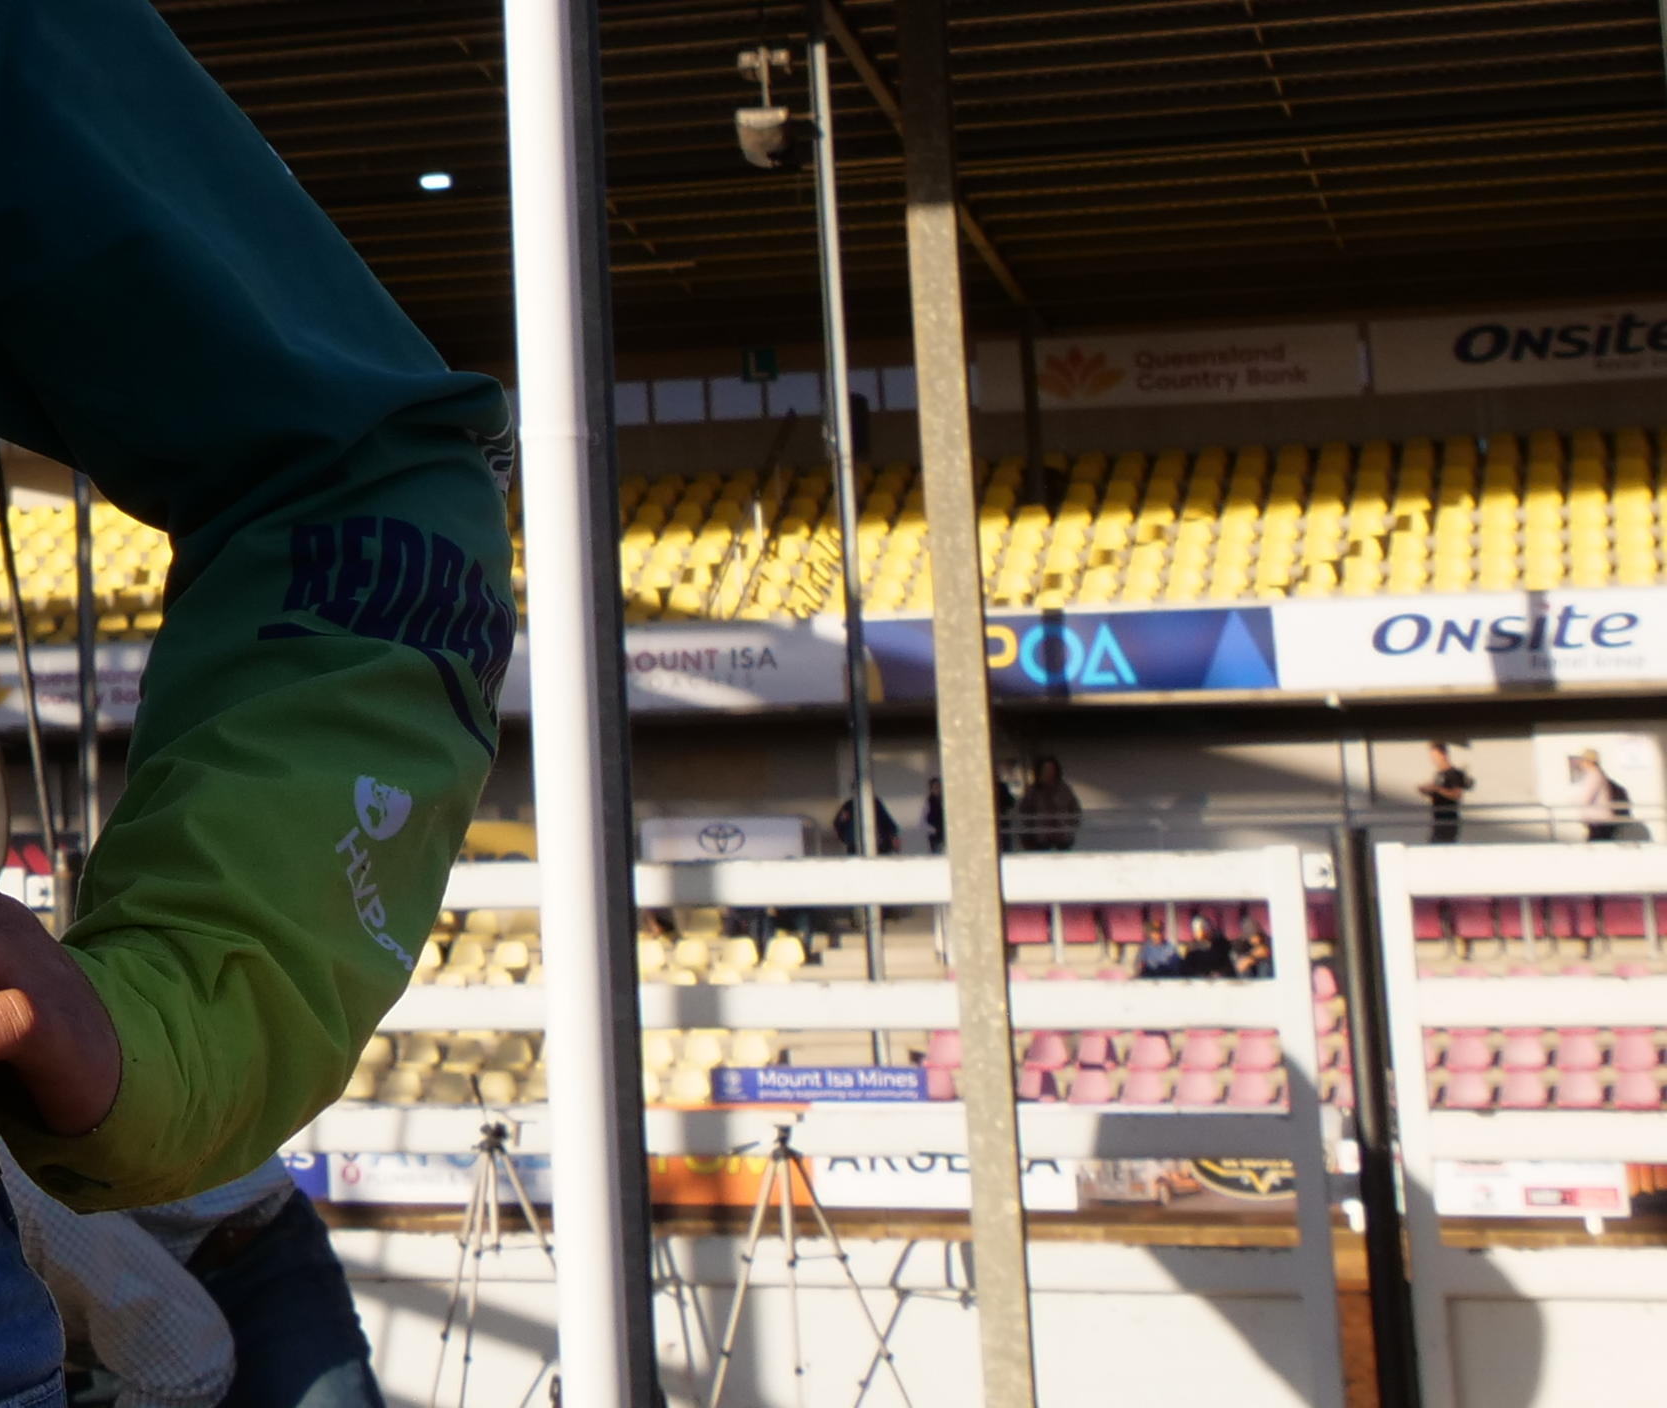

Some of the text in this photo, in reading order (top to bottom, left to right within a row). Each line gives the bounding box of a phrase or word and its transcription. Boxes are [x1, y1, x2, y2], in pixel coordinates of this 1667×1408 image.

[625, 647, 778, 673] OUNT ISA
[757, 1070, 918, 1088] Mount Isa Mines
